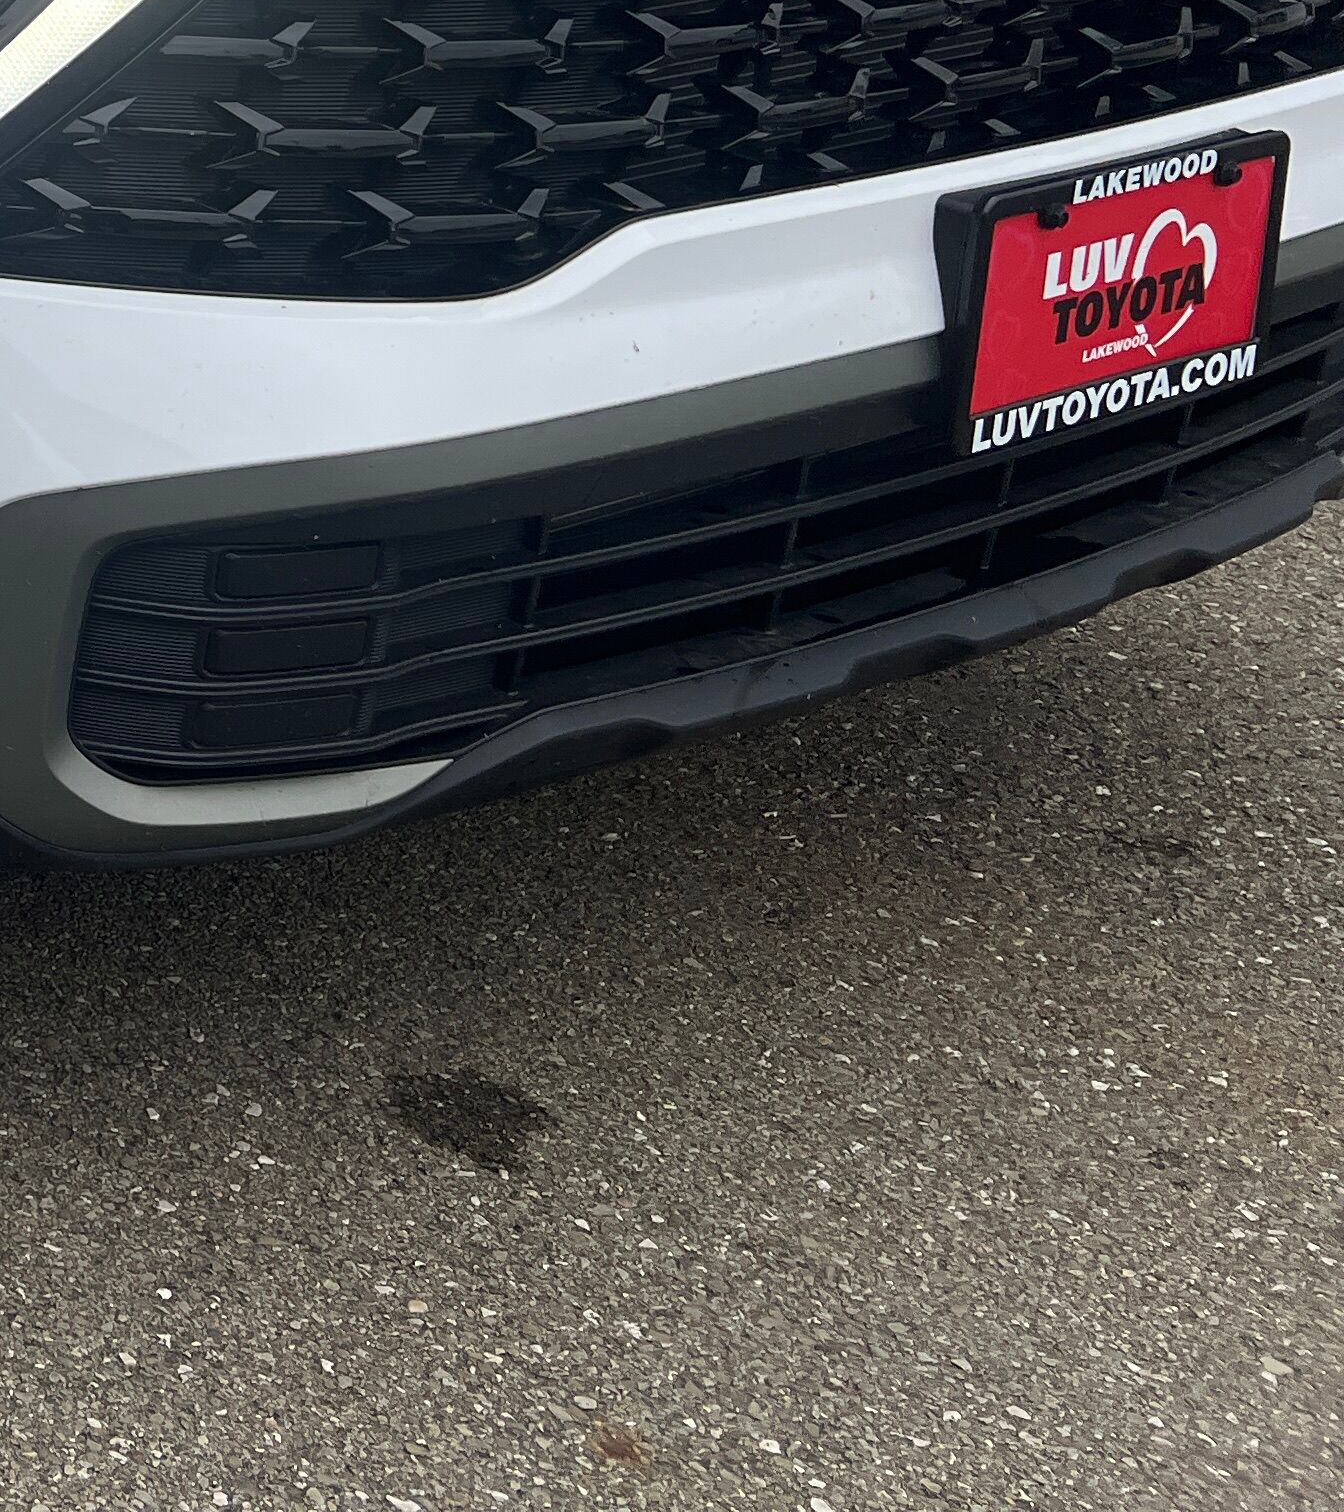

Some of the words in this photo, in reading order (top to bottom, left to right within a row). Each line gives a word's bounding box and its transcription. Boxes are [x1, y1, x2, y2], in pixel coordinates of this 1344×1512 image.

[1072, 149, 1218, 205] LAKEWOOD
[1042, 232, 1135, 300] LUV
[1052, 262, 1206, 345] TOYOTA
[1081, 332, 1150, 364] LAKEWOOD
[971, 344, 1258, 455] LUVTOYOTA.COM
